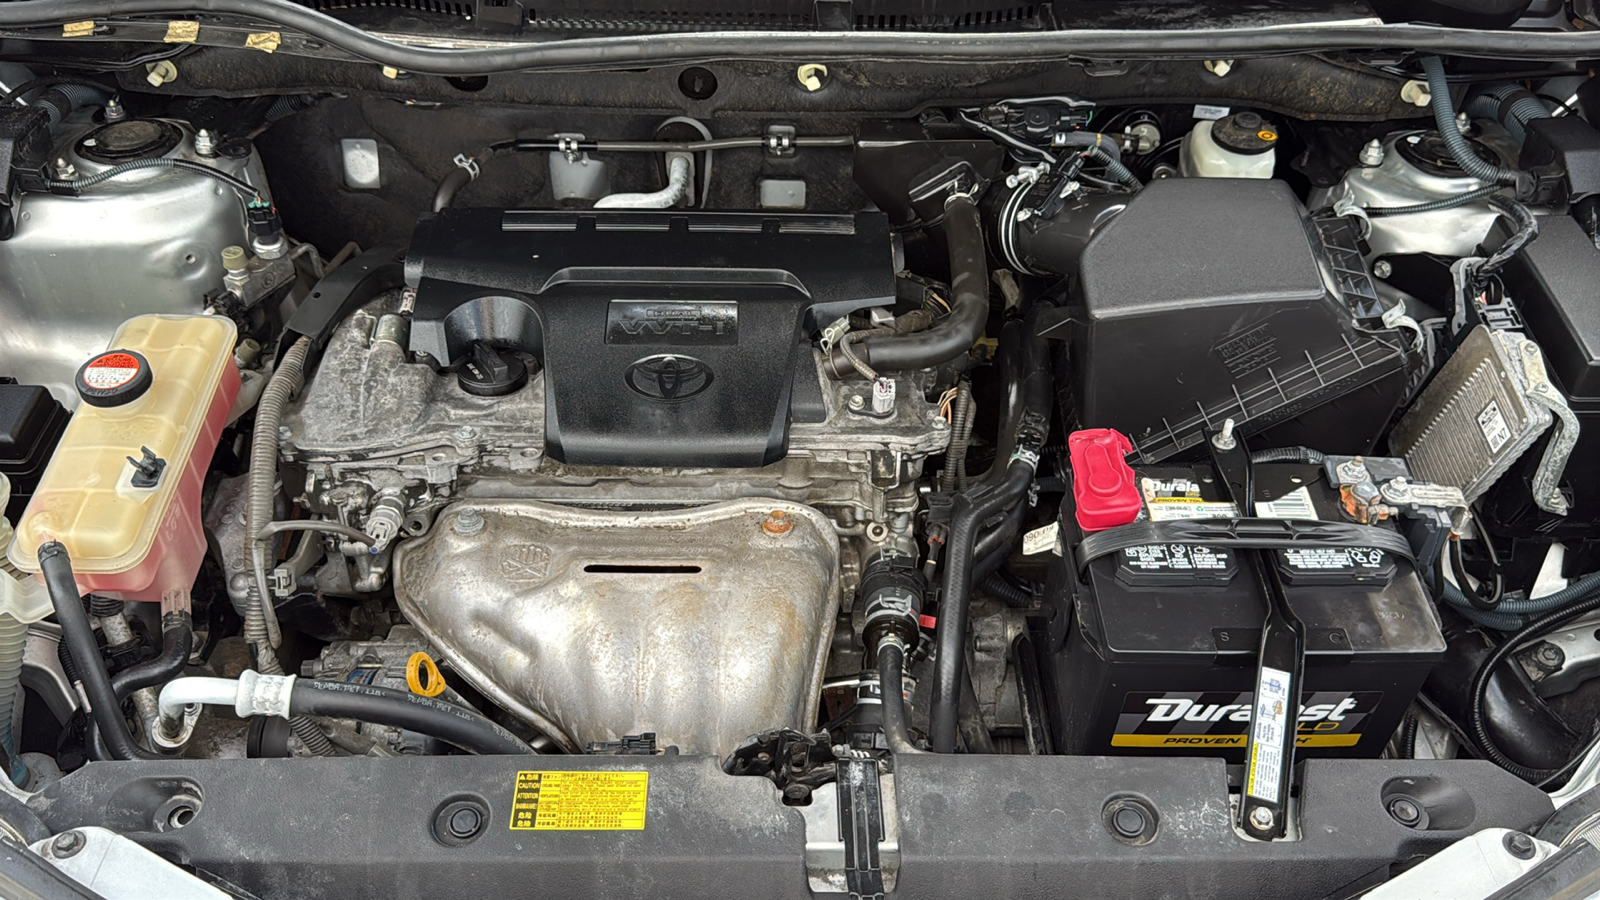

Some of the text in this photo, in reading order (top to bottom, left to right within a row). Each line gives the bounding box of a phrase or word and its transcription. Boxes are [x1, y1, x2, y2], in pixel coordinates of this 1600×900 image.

[1150, 481, 1200, 491] Durala
[1145, 698, 1357, 722] Durast
[1163, 737, 1241, 745] PROVEN
